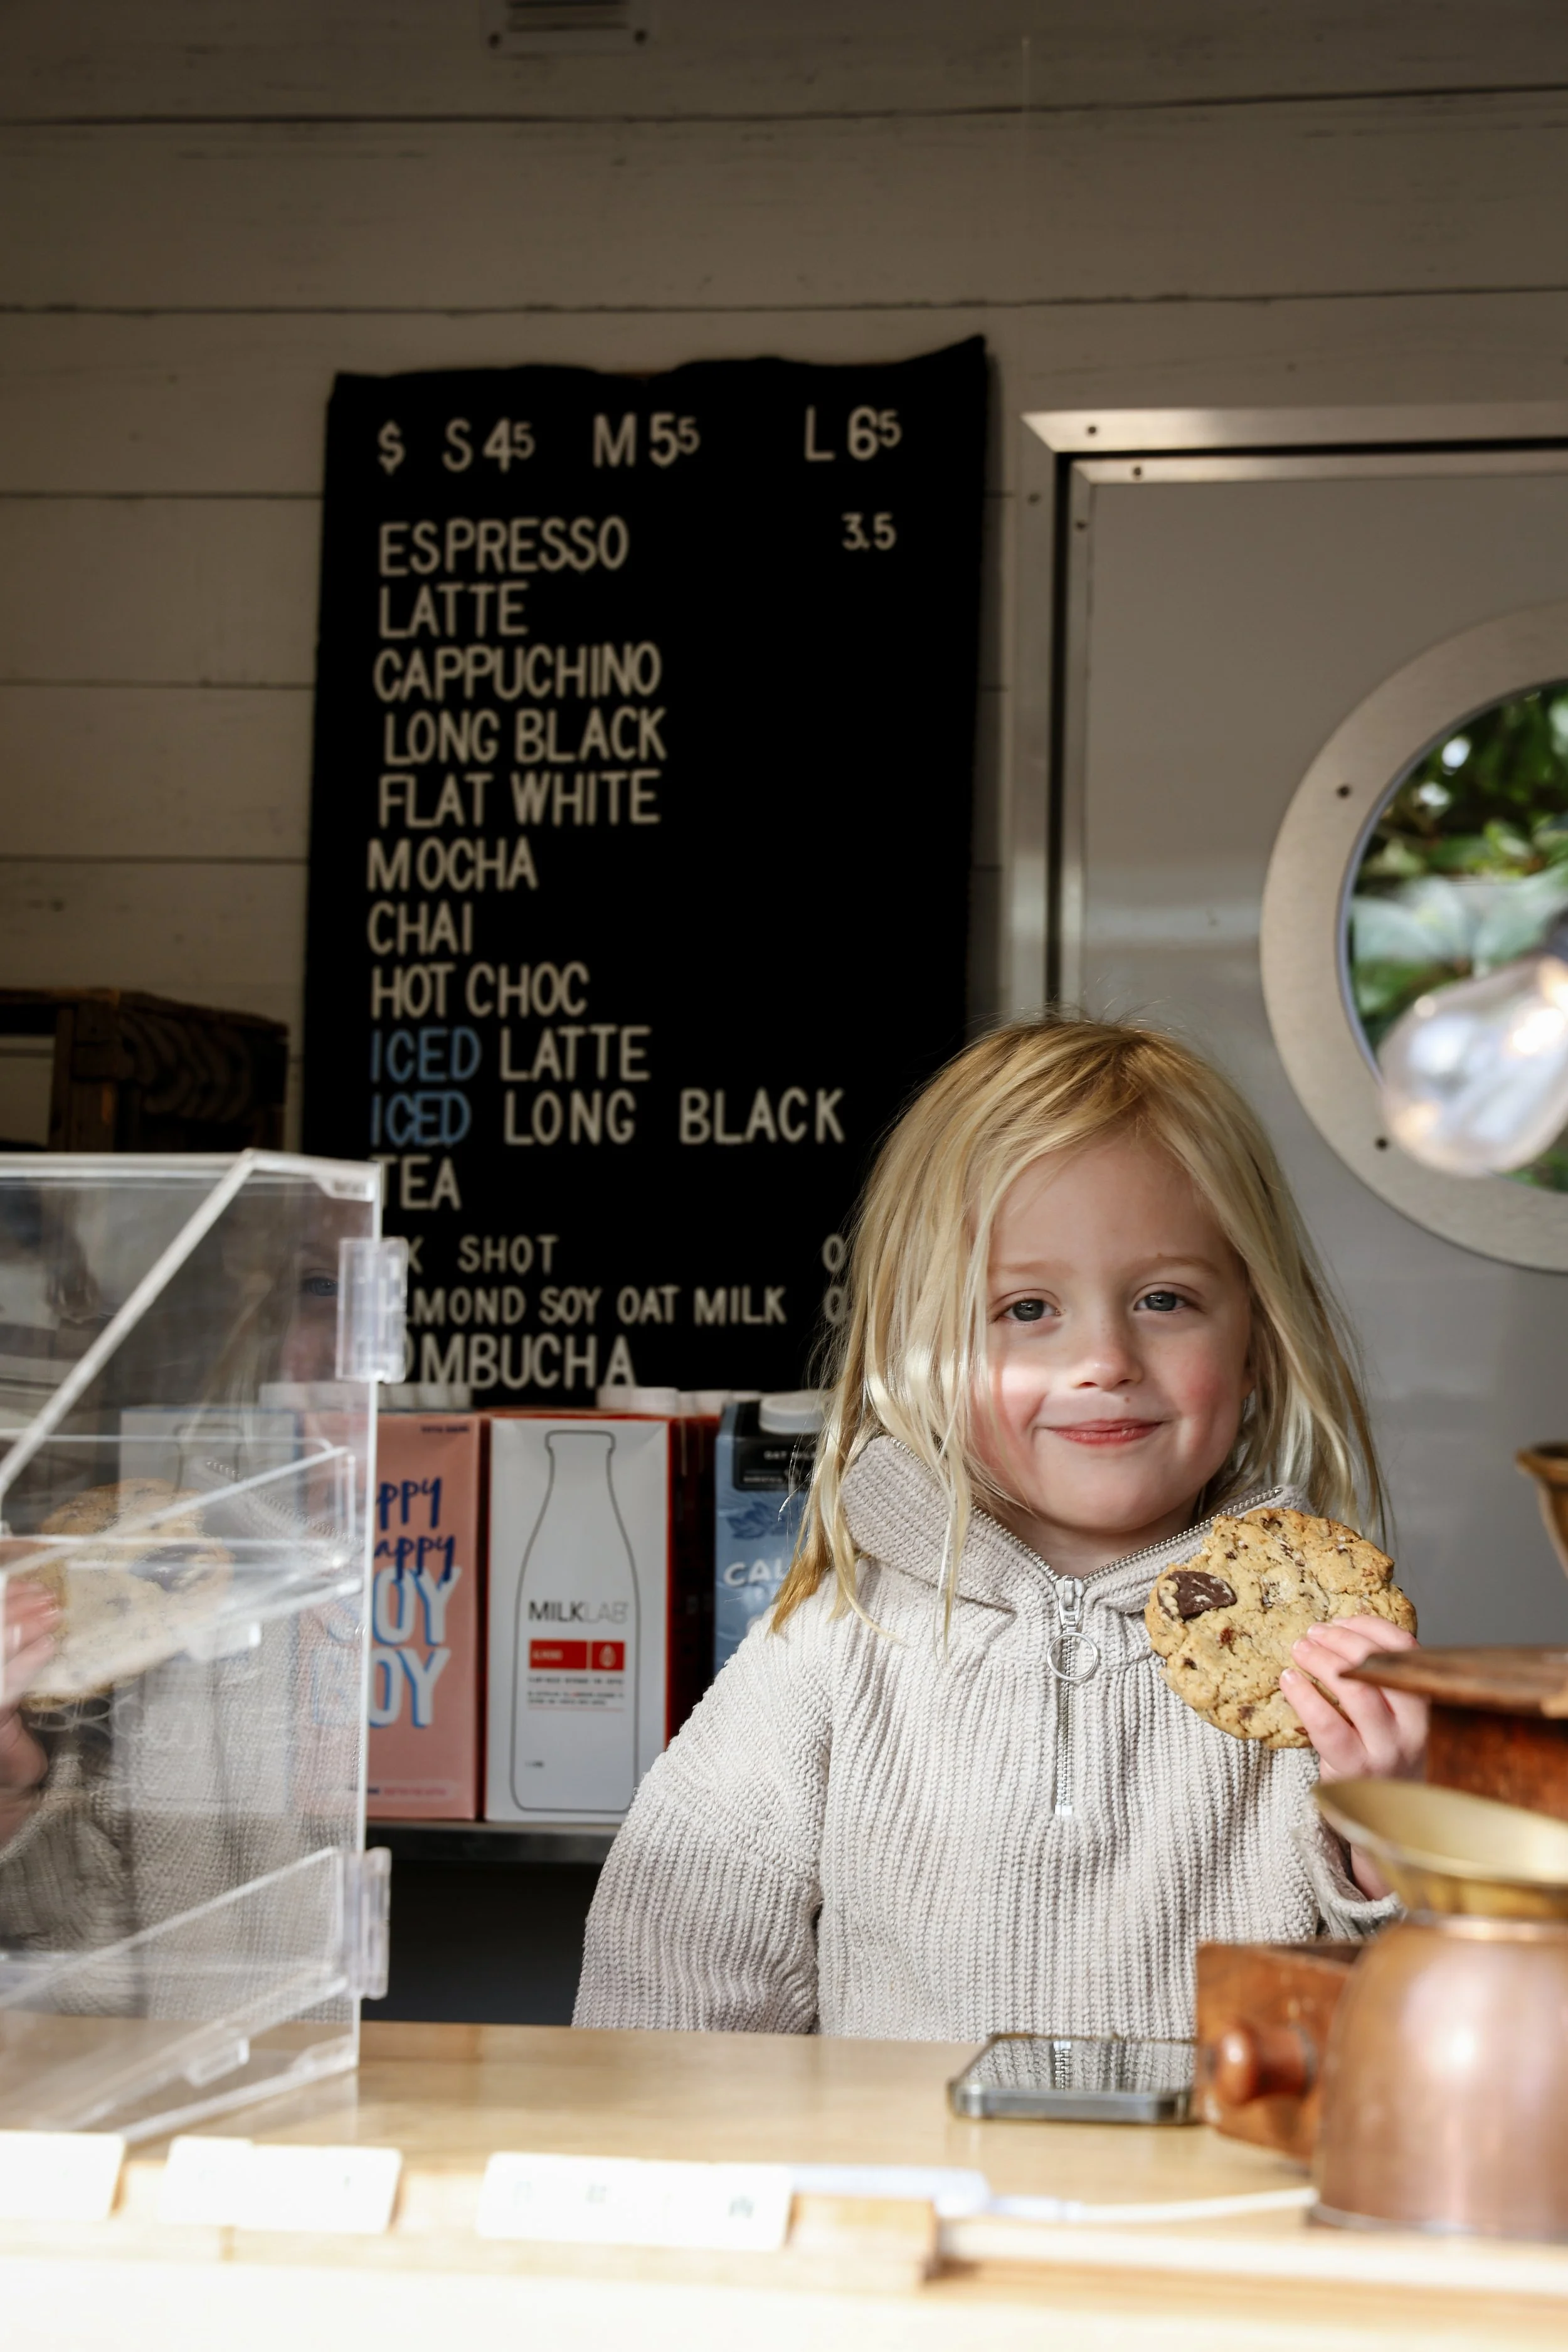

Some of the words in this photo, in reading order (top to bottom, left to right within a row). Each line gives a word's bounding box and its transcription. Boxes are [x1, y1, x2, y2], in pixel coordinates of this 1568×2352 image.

[378, 421, 405, 474] $
[379, 516, 630, 575] ESPRESSO
[842, 512, 897, 551] 3.5
[379, 580, 529, 639] LATTE
[373, 642, 662, 701] CAPPUCHINO
[384, 709, 501, 766] LONG
[514, 706, 667, 763] BLACK
[379, 772, 494, 829] FLAT
[509, 768, 662, 827] WHITE
[366, 835, 539, 893] MOCHA
[366, 901, 473, 956] CHAI
[371, 961, 456, 1020] HOT
[465, 961, 590, 1019] CHOC
[371, 1026, 482, 1083] ICED
[499, 1024, 652, 1083] LATTE
[371, 1089, 472, 1147] ICED
[503, 1088, 637, 1147] LONG
[679, 1086, 845, 1146] BLACK
[368, 1154, 462, 1212] TEA
[457, 1234, 558, 1275] SHOT
[406, 1286, 527, 1327] MOND
[538, 1285, 602, 1326] SOY
[616, 1284, 681, 1325] OAT
[693, 1285, 787, 1326] MILK
[403, 1332, 637, 1389] MBUCHA
[529, 1600, 628, 1624] MILKLAB
